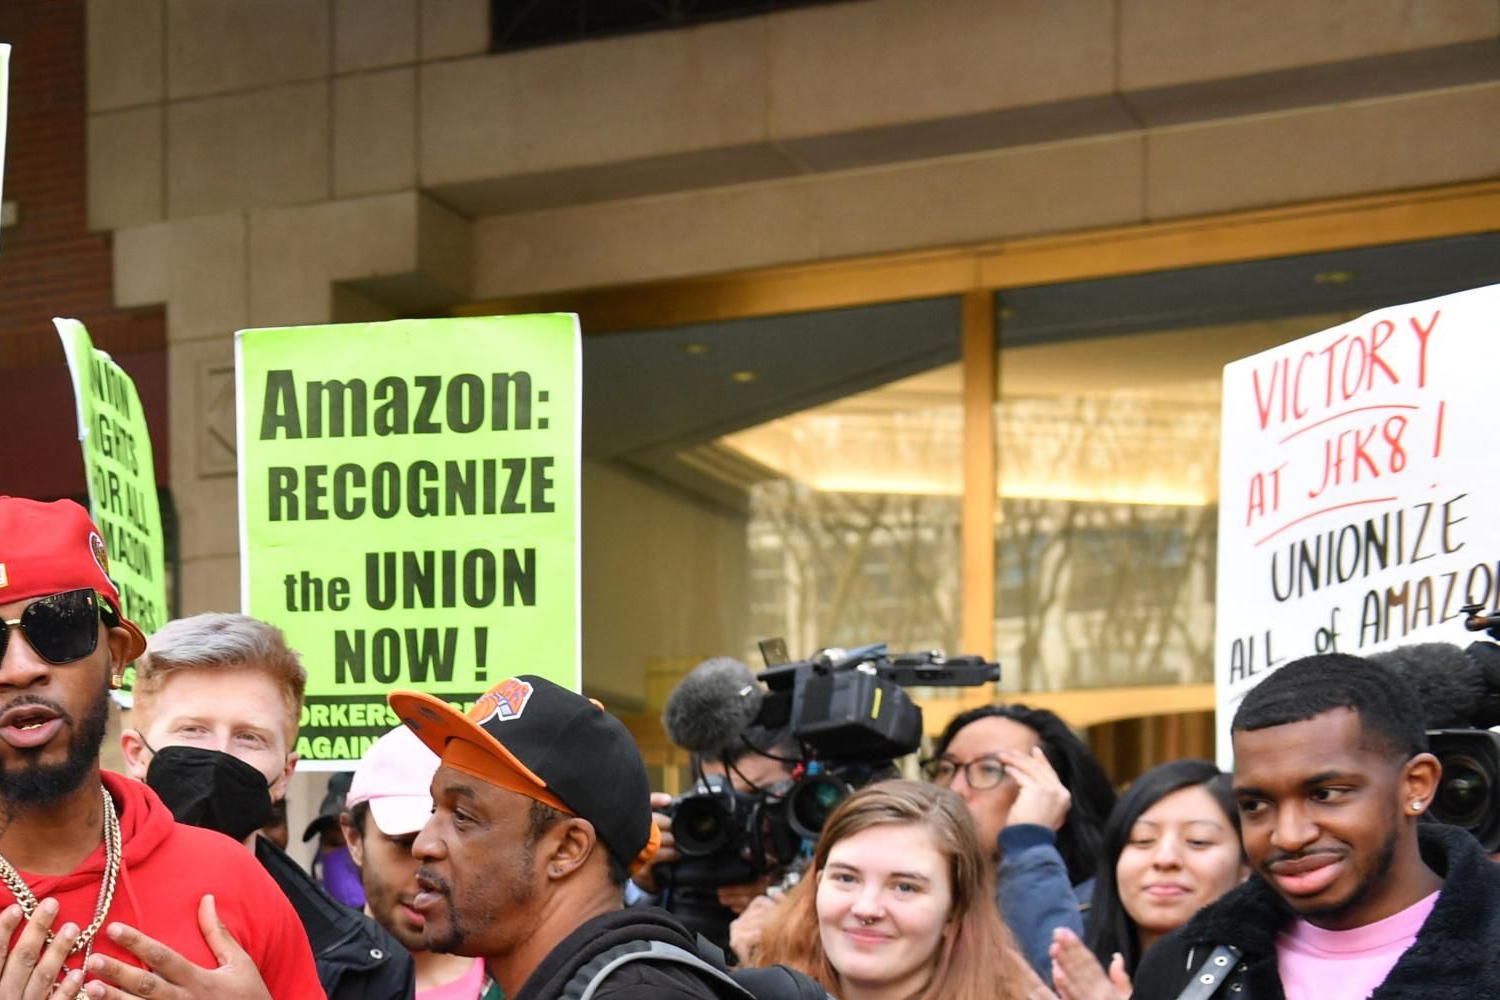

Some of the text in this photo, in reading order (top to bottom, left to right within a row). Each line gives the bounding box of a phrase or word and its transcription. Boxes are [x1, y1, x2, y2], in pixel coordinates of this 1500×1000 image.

[1252, 309, 1443, 432] VICTORY
[259, 368, 550, 441] Amazon:
[267, 456, 556, 522] RECOGNIZE
[1246, 461, 1290, 528] AT
[1308, 414, 1409, 499] JFK8
[284, 547, 537, 613] the UNION
[1271, 493, 1470, 603] UNIONIZE
[333, 626, 459, 685] NOW
[1230, 629, 1285, 685] ALL
[298, 703, 402, 727] ORKERS
